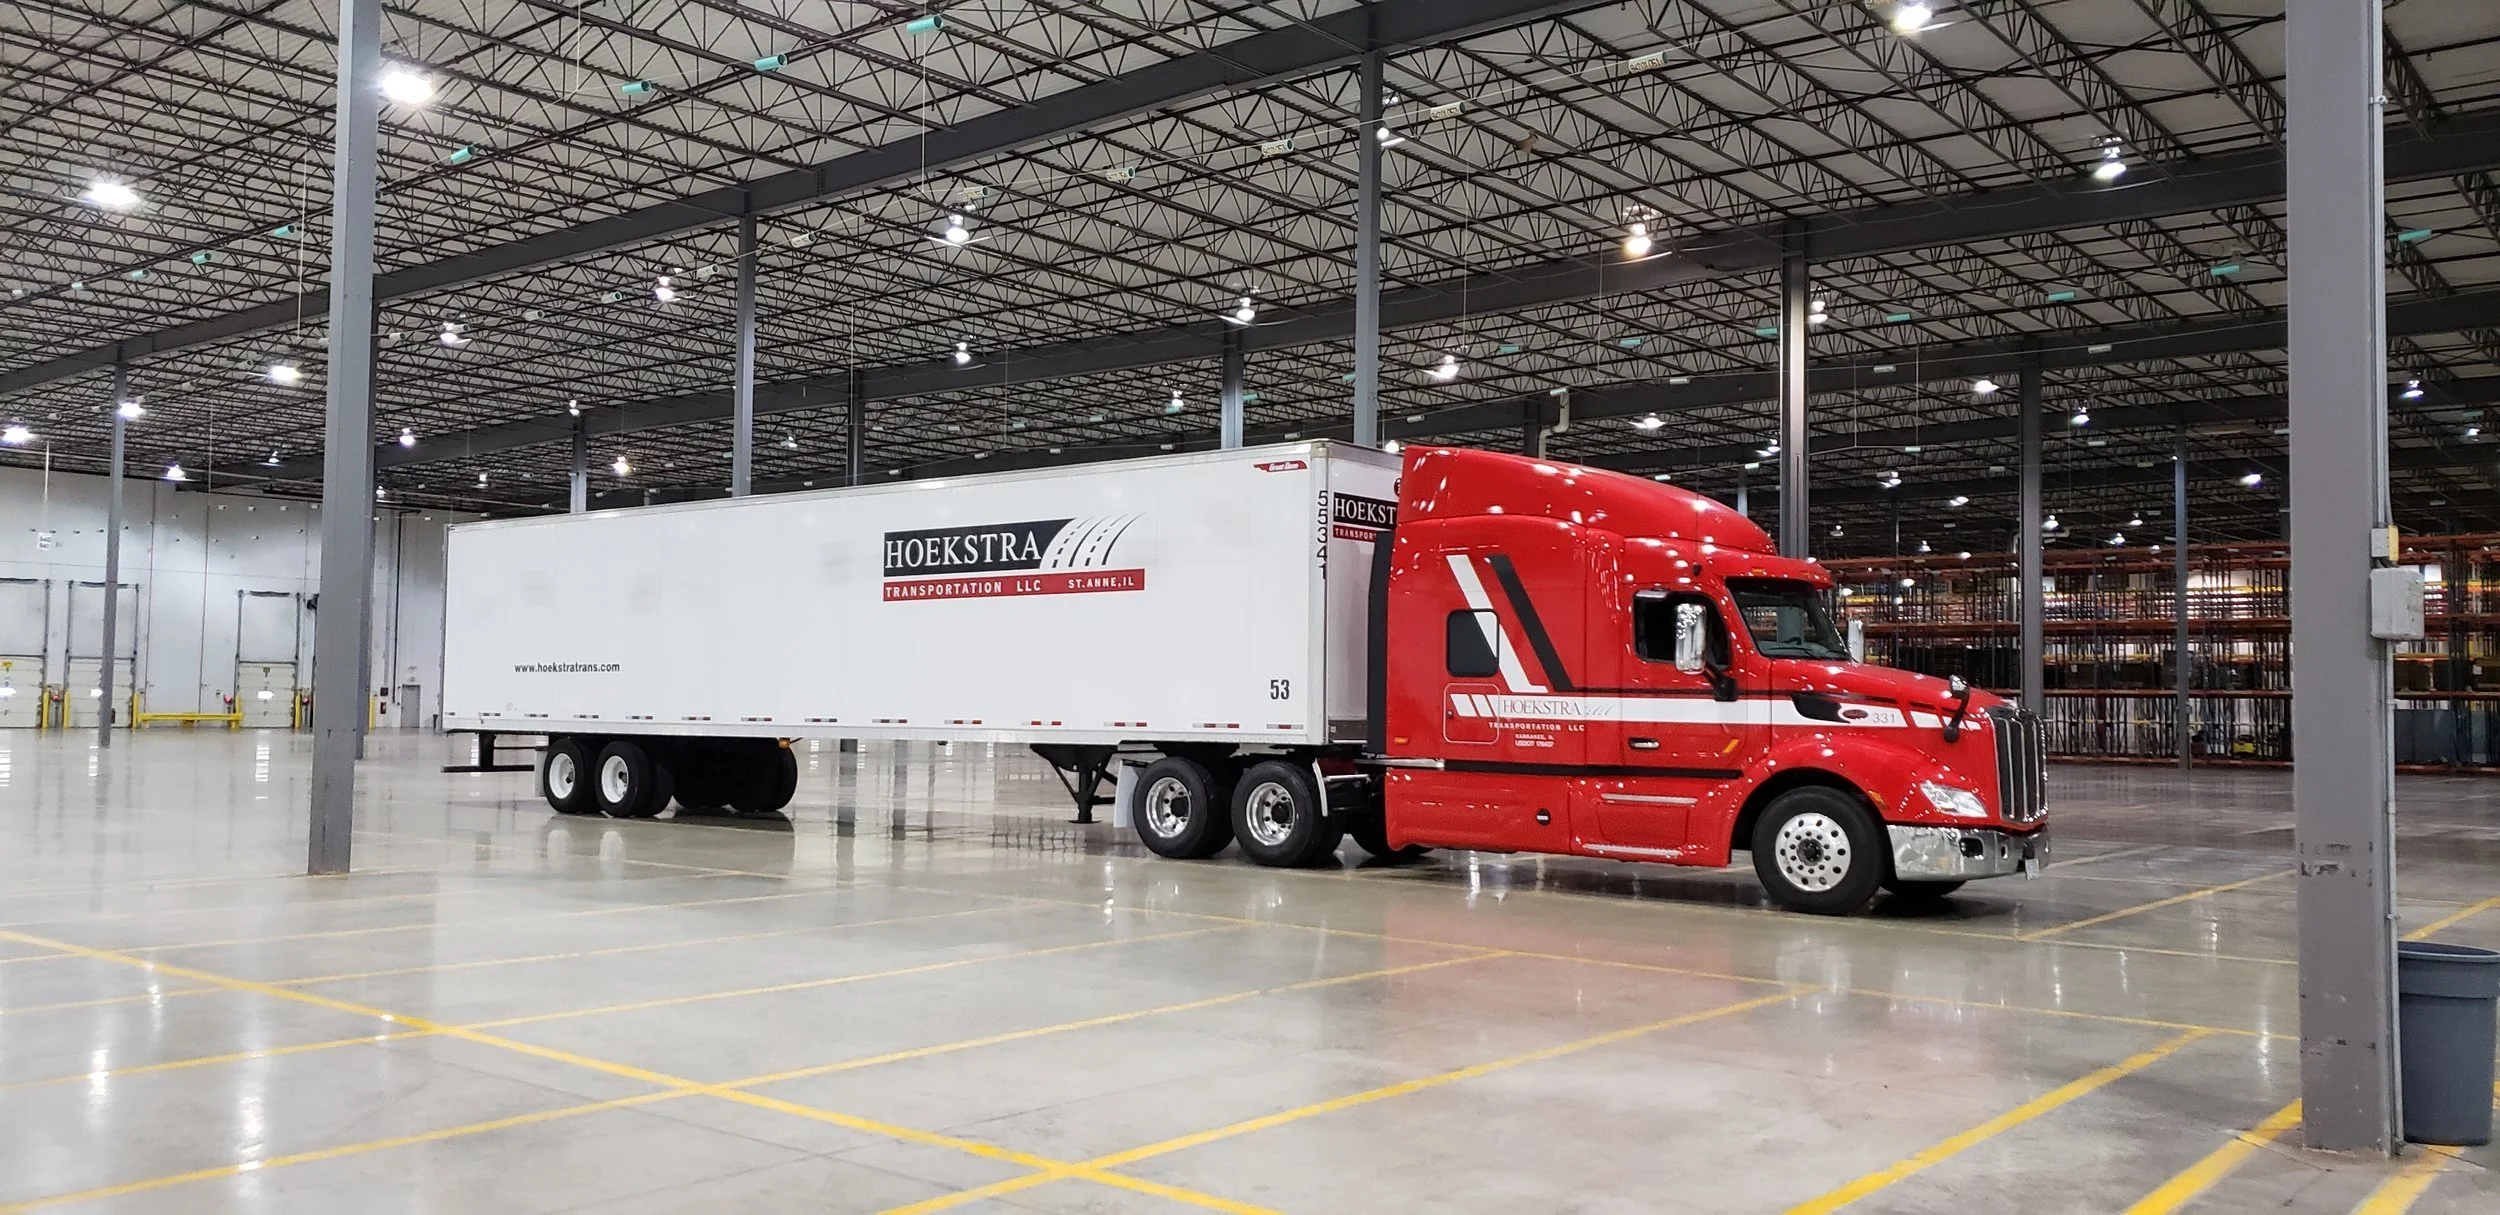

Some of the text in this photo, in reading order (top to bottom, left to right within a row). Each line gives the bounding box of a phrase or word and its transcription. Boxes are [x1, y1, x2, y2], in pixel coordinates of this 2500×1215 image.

[1334, 497, 1397, 525] HOEKST
[1316, 490, 1328, 580] 55341
[884, 530, 1043, 569] HOEKSTRA
[885, 582, 1002, 598] TRANSPORTATION
[1016, 580, 1041, 593] LLC
[514, 661, 620, 673] www.hoekstratrans.com
[1270, 679, 1290, 700] 53
[1503, 698, 1582, 716] HOEKSTRA
[1488, 721, 1585, 732] TRANSPORTATION LLC
[1872, 712, 1896, 724] 331
